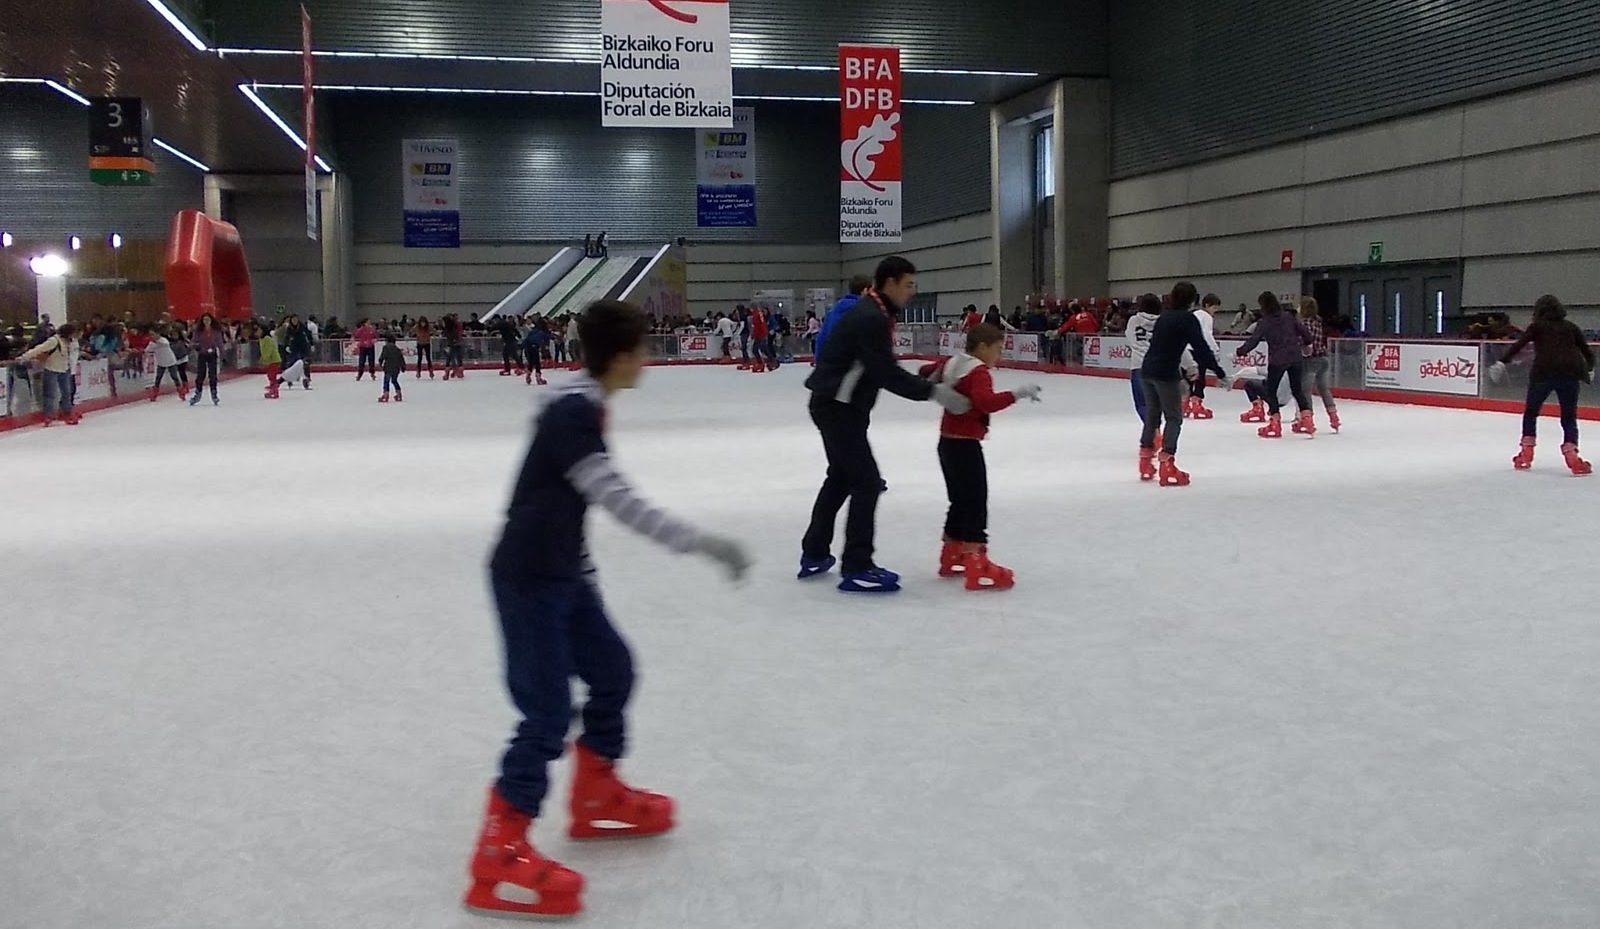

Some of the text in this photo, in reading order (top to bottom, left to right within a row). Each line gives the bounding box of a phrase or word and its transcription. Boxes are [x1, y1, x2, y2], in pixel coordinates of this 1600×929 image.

[603, 35, 714, 53] Bizkaiko Foru
[603, 53, 680, 70] Aldundia
[845, 57, 893, 80] BFA
[603, 82, 695, 102] Diputación
[845, 87, 893, 110] DFB
[108, 102, 122, 127] 3
[604, 101, 732, 118] Foral de Bizkaia
[841, 197, 894, 206] Bizkaiko Foru
[841, 206, 877, 215] Aldundia
[841, 220, 885, 230] Diputación
[841, 229, 901, 237] Foral de Bizkaia
[1384, 347, 1399, 357] BFA
[1384, 358, 1399, 369] DFB
